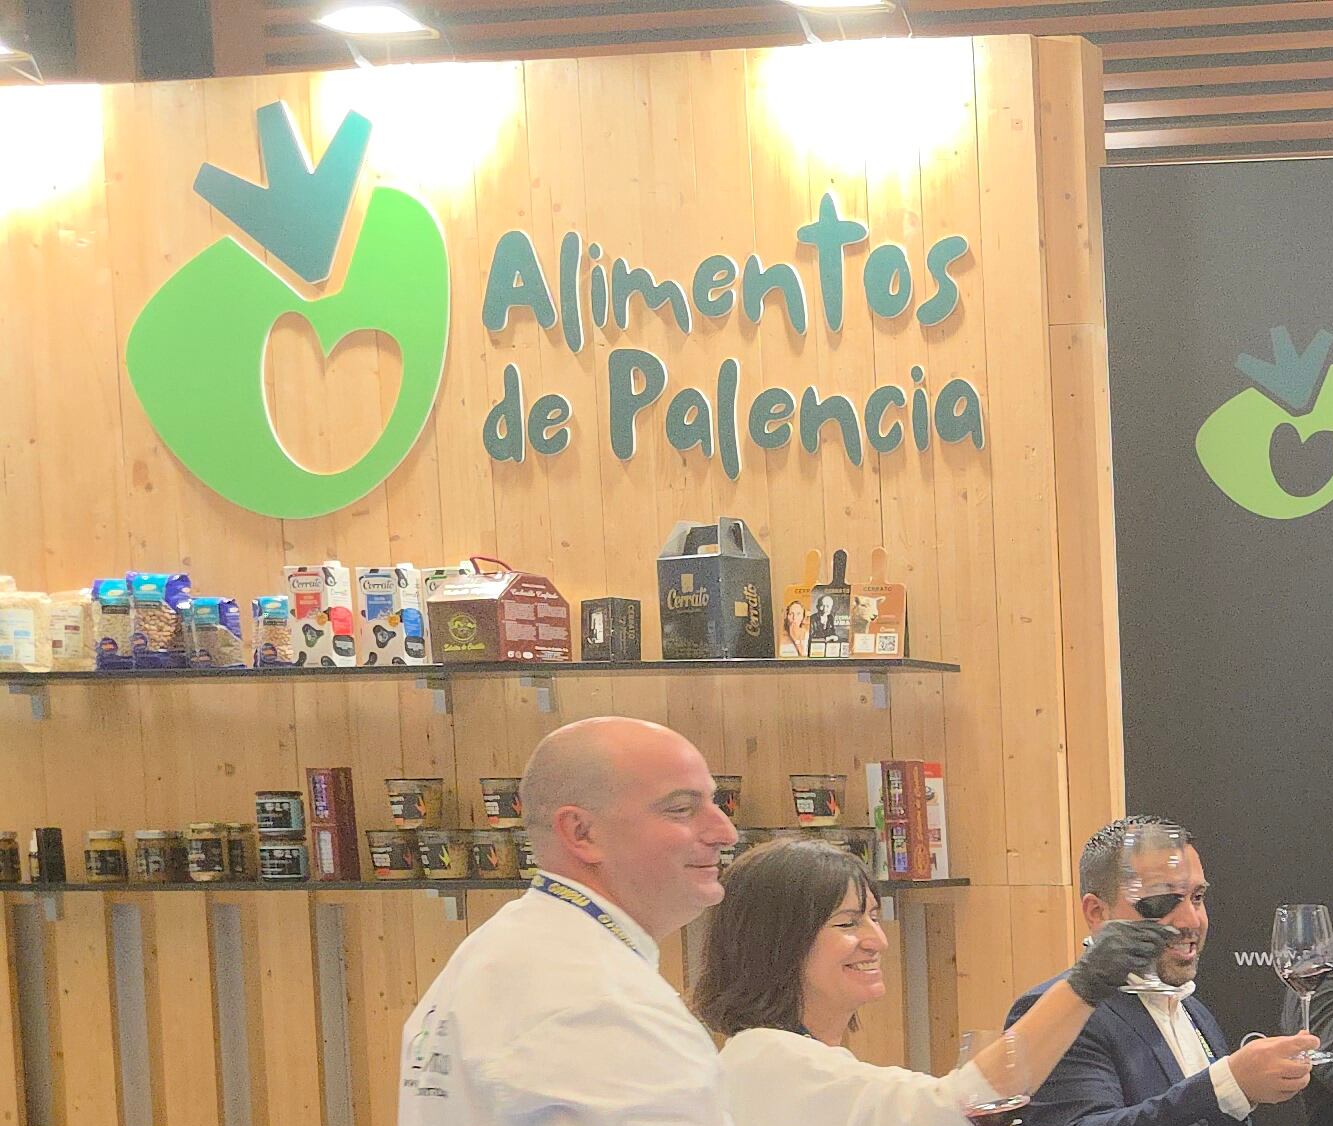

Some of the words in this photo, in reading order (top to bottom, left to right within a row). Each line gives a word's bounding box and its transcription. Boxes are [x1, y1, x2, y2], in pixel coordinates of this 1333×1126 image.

[482, 192, 969, 352] Alimentos
[483, 363, 571, 464] de
[607, 348, 985, 480] Palencia
[666, 585, 710, 611] Cerrato
